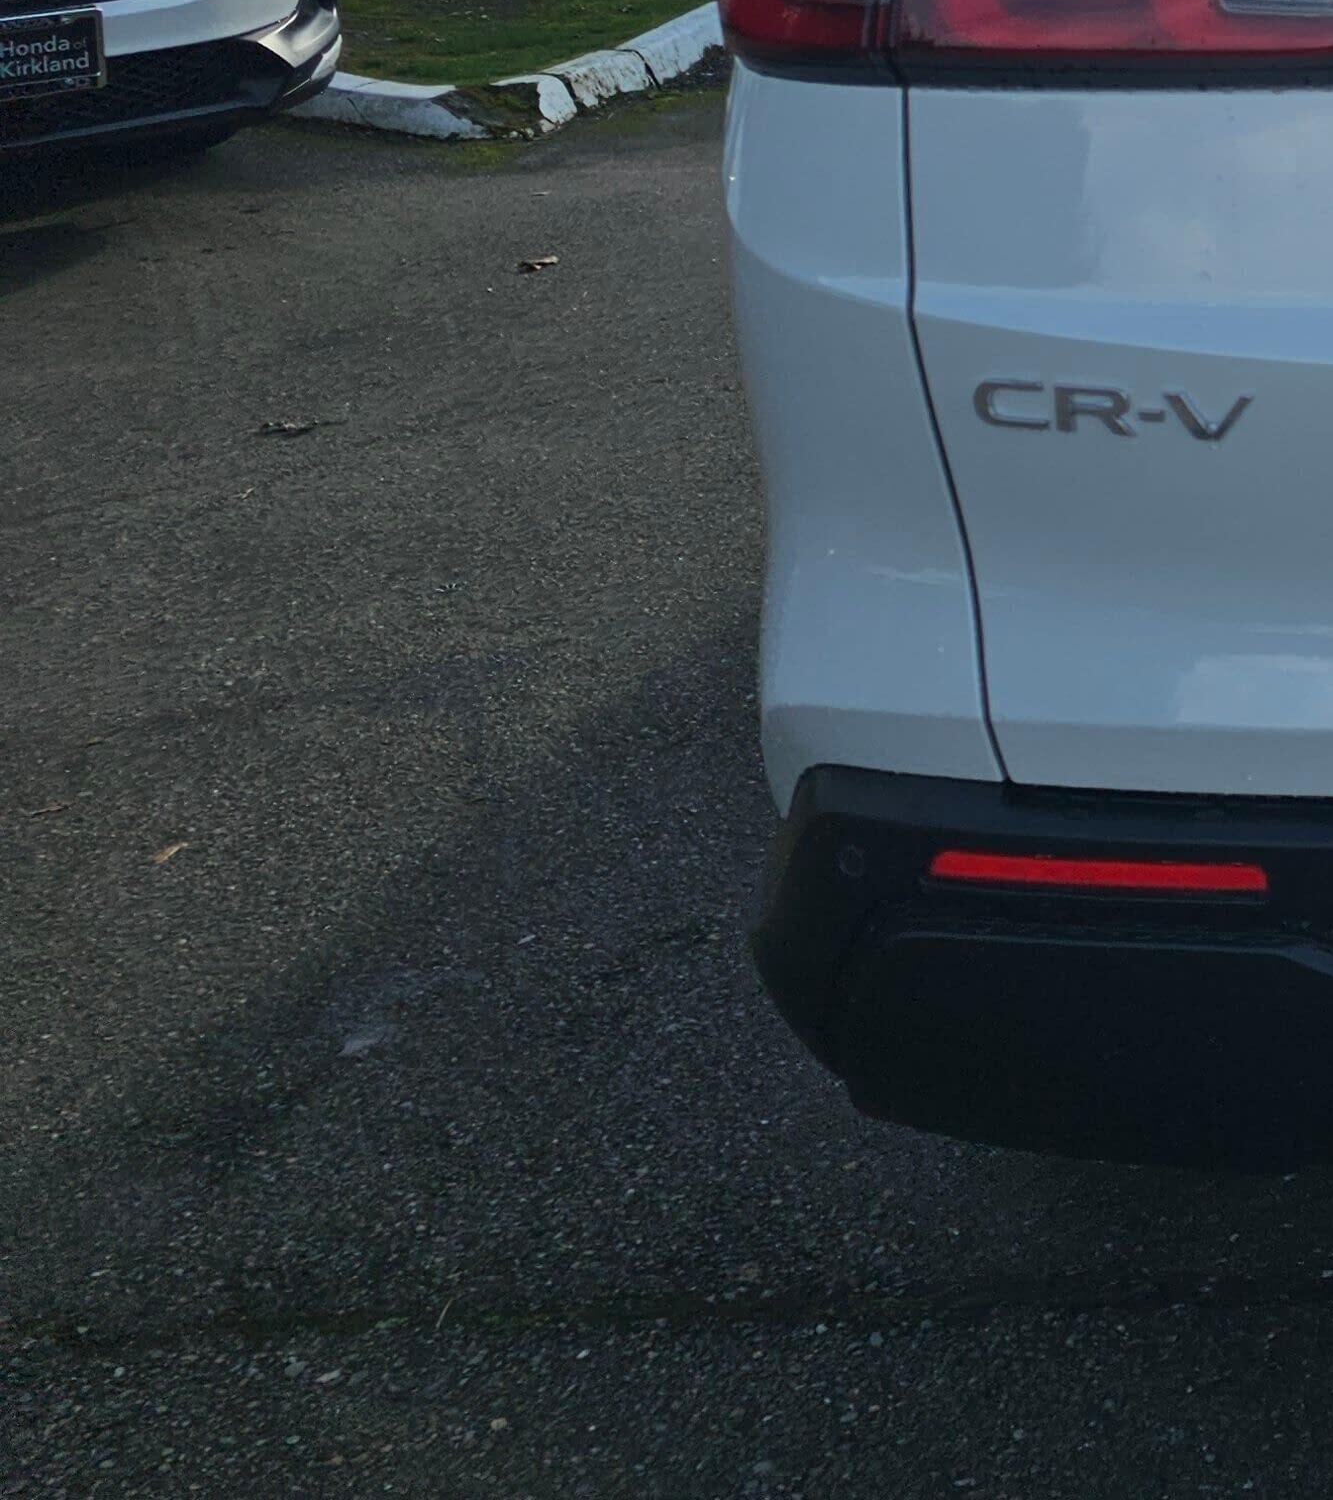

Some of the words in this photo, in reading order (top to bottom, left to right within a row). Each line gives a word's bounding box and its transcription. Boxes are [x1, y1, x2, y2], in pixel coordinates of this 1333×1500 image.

[0, 34, 70, 59] Honda
[0, 51, 90, 79] Kirkland
[973, 378, 1255, 441] CR-V
